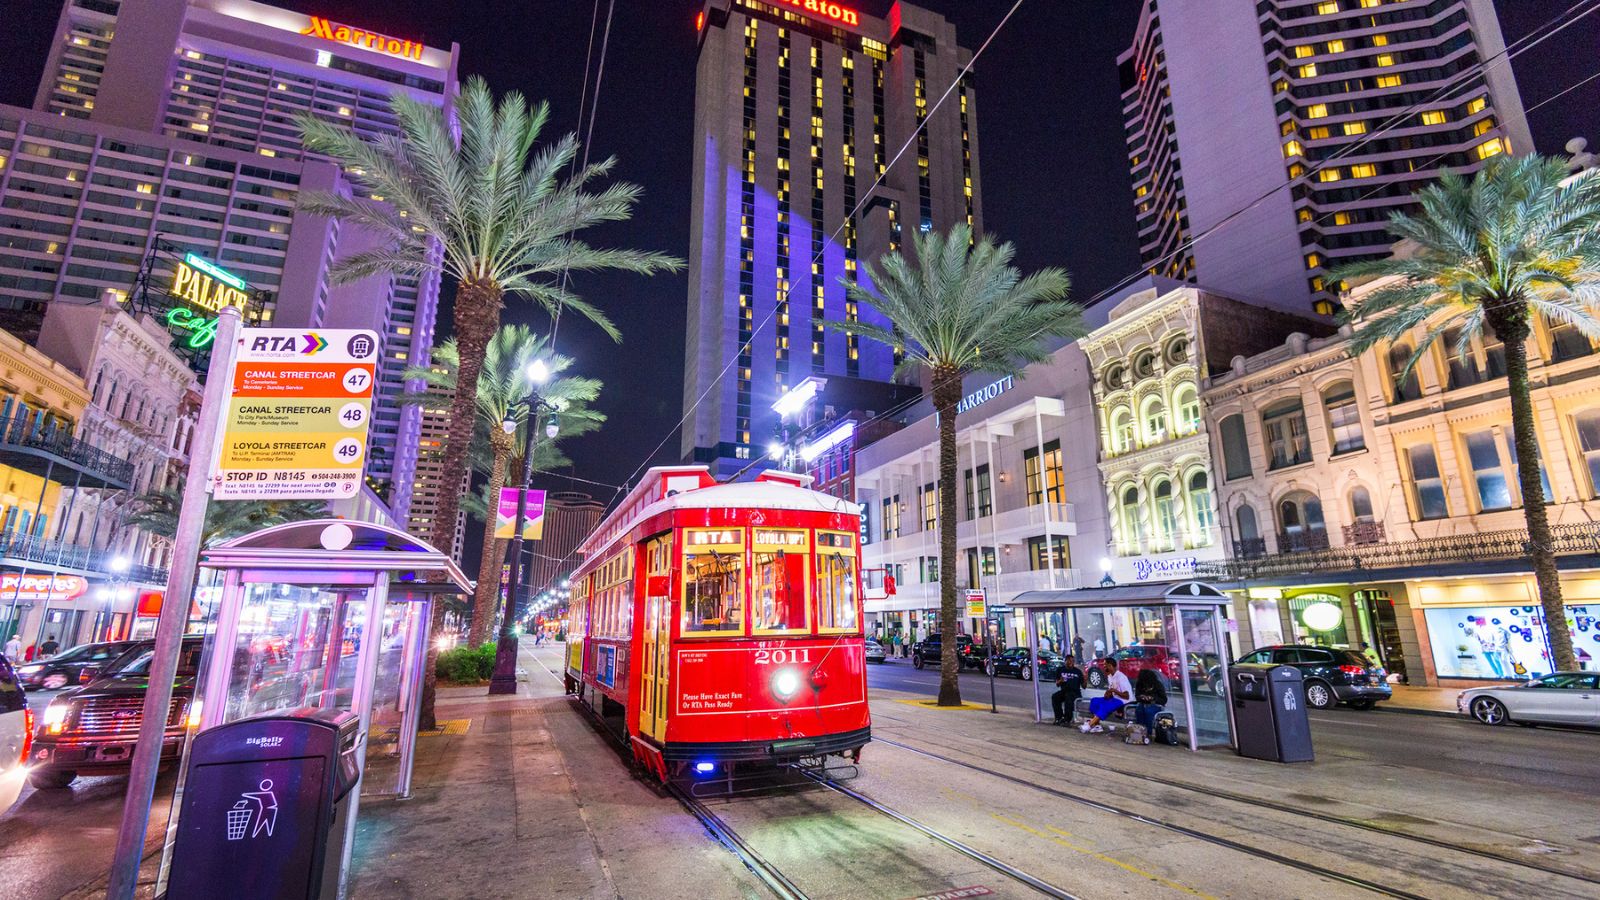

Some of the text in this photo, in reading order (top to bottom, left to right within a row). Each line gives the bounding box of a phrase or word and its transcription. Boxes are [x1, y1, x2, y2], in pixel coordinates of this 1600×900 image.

[781, 0, 858, 25] aton
[299, 15, 424, 60] Marriott
[168, 308, 220, 347] Caf
[251, 337, 296, 351] RTA
[244, 370, 337, 379] CANAL STREETCAR
[348, 375, 366, 386] 47
[239, 406, 332, 414] CANAL STREETCAR
[343, 409, 362, 421] 48
[233, 442, 326, 450] LOYOLA STREETCAR
[338, 445, 358, 457] 49
[226, 471, 357, 481] STOP ID N8145 504-248-3900
[693, 531, 735, 544] RTA
[834, 536, 842, 546] 3
[754, 649, 811, 664] 2011
[700, 692, 713, 700] Have
[731, 691, 743, 699] Fare
[682, 701, 690, 709] Or
[691, 701, 703, 709] RTA
[717, 700, 733, 709] Ready
[246, 736, 284, 745] BigBelly
